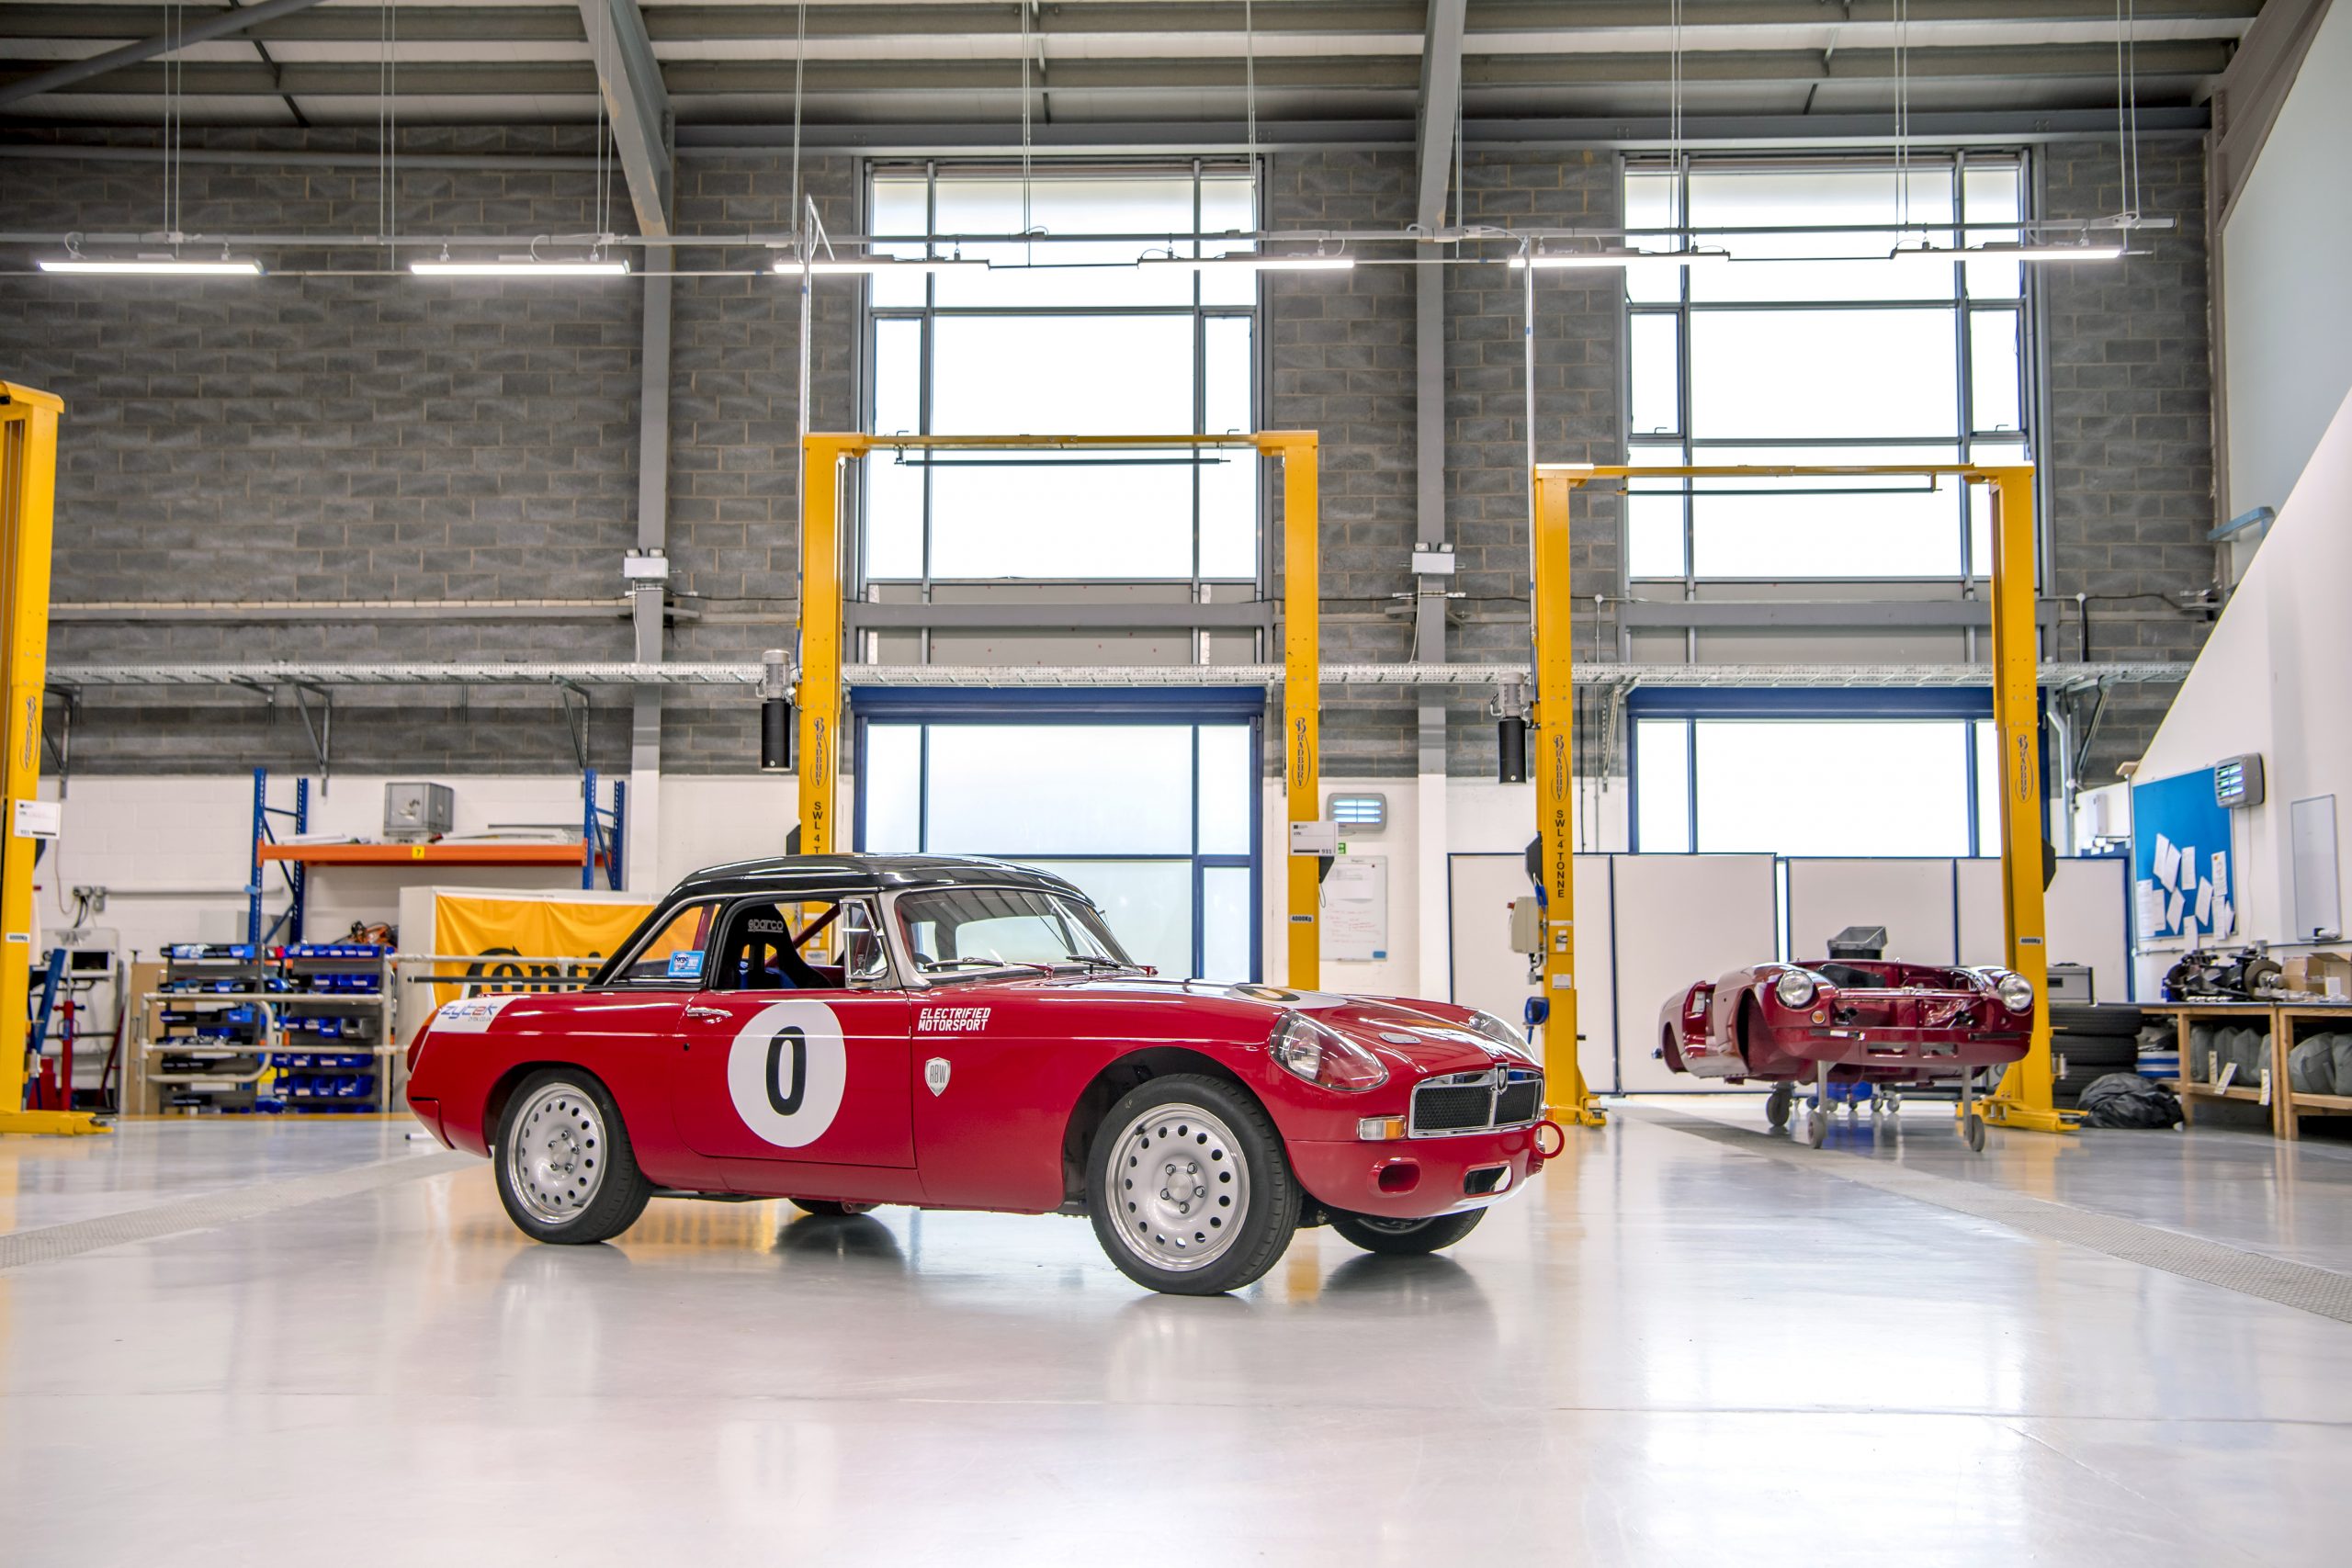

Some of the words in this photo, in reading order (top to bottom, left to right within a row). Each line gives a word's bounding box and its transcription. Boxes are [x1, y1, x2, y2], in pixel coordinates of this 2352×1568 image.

[1295, 717, 1306, 786] BRADBURY
[812, 801, 823, 829] SWL
[1555, 809, 1566, 837] SWL
[813, 834, 820, 842] 4
[1557, 840, 1564, 848] 4
[1556, 852, 1566, 898] TONNE
[917, 1019, 989, 1031] MOTORSPORT
[920, 1008, 991, 1020] ELECTRIFIED
[766, 1025, 807, 1116] 0
